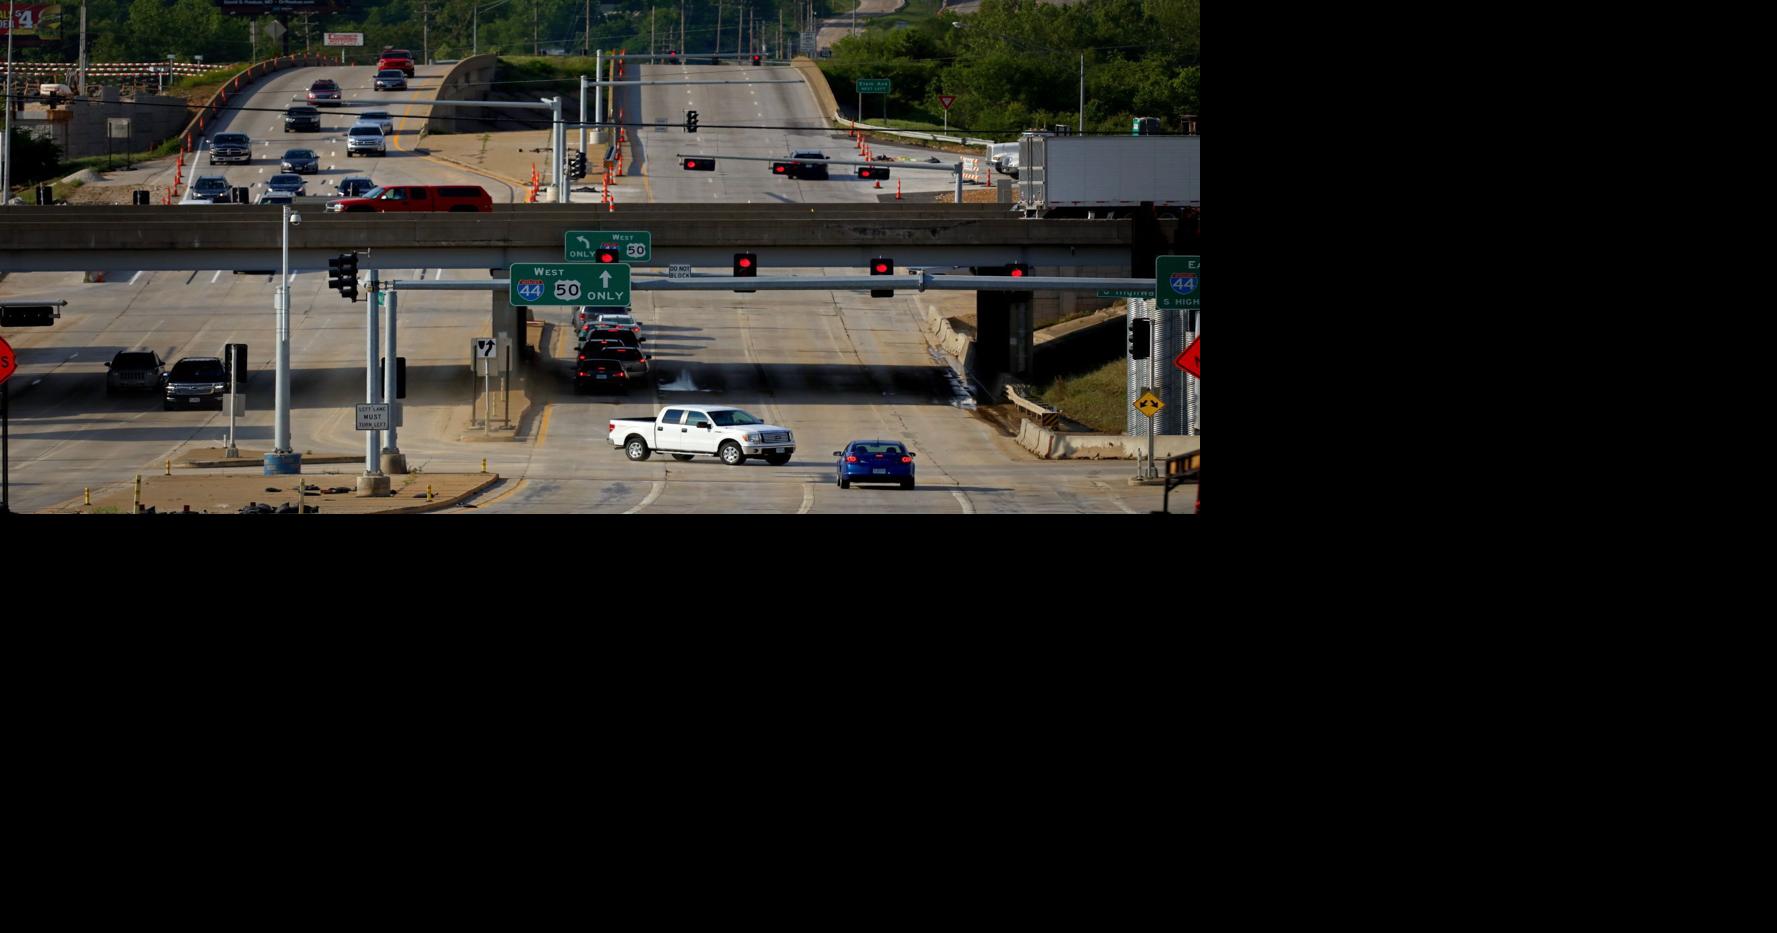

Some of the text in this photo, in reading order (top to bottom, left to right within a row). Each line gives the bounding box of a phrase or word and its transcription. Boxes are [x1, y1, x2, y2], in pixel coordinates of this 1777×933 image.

[15, 10, 33, 29] $4
[569, 250, 596, 258] ONLY
[628, 245, 645, 255] 50
[519, 283, 579, 296] 44 50
[1173, 278, 1194, 290] 44
[587, 291, 624, 300] ONLY
